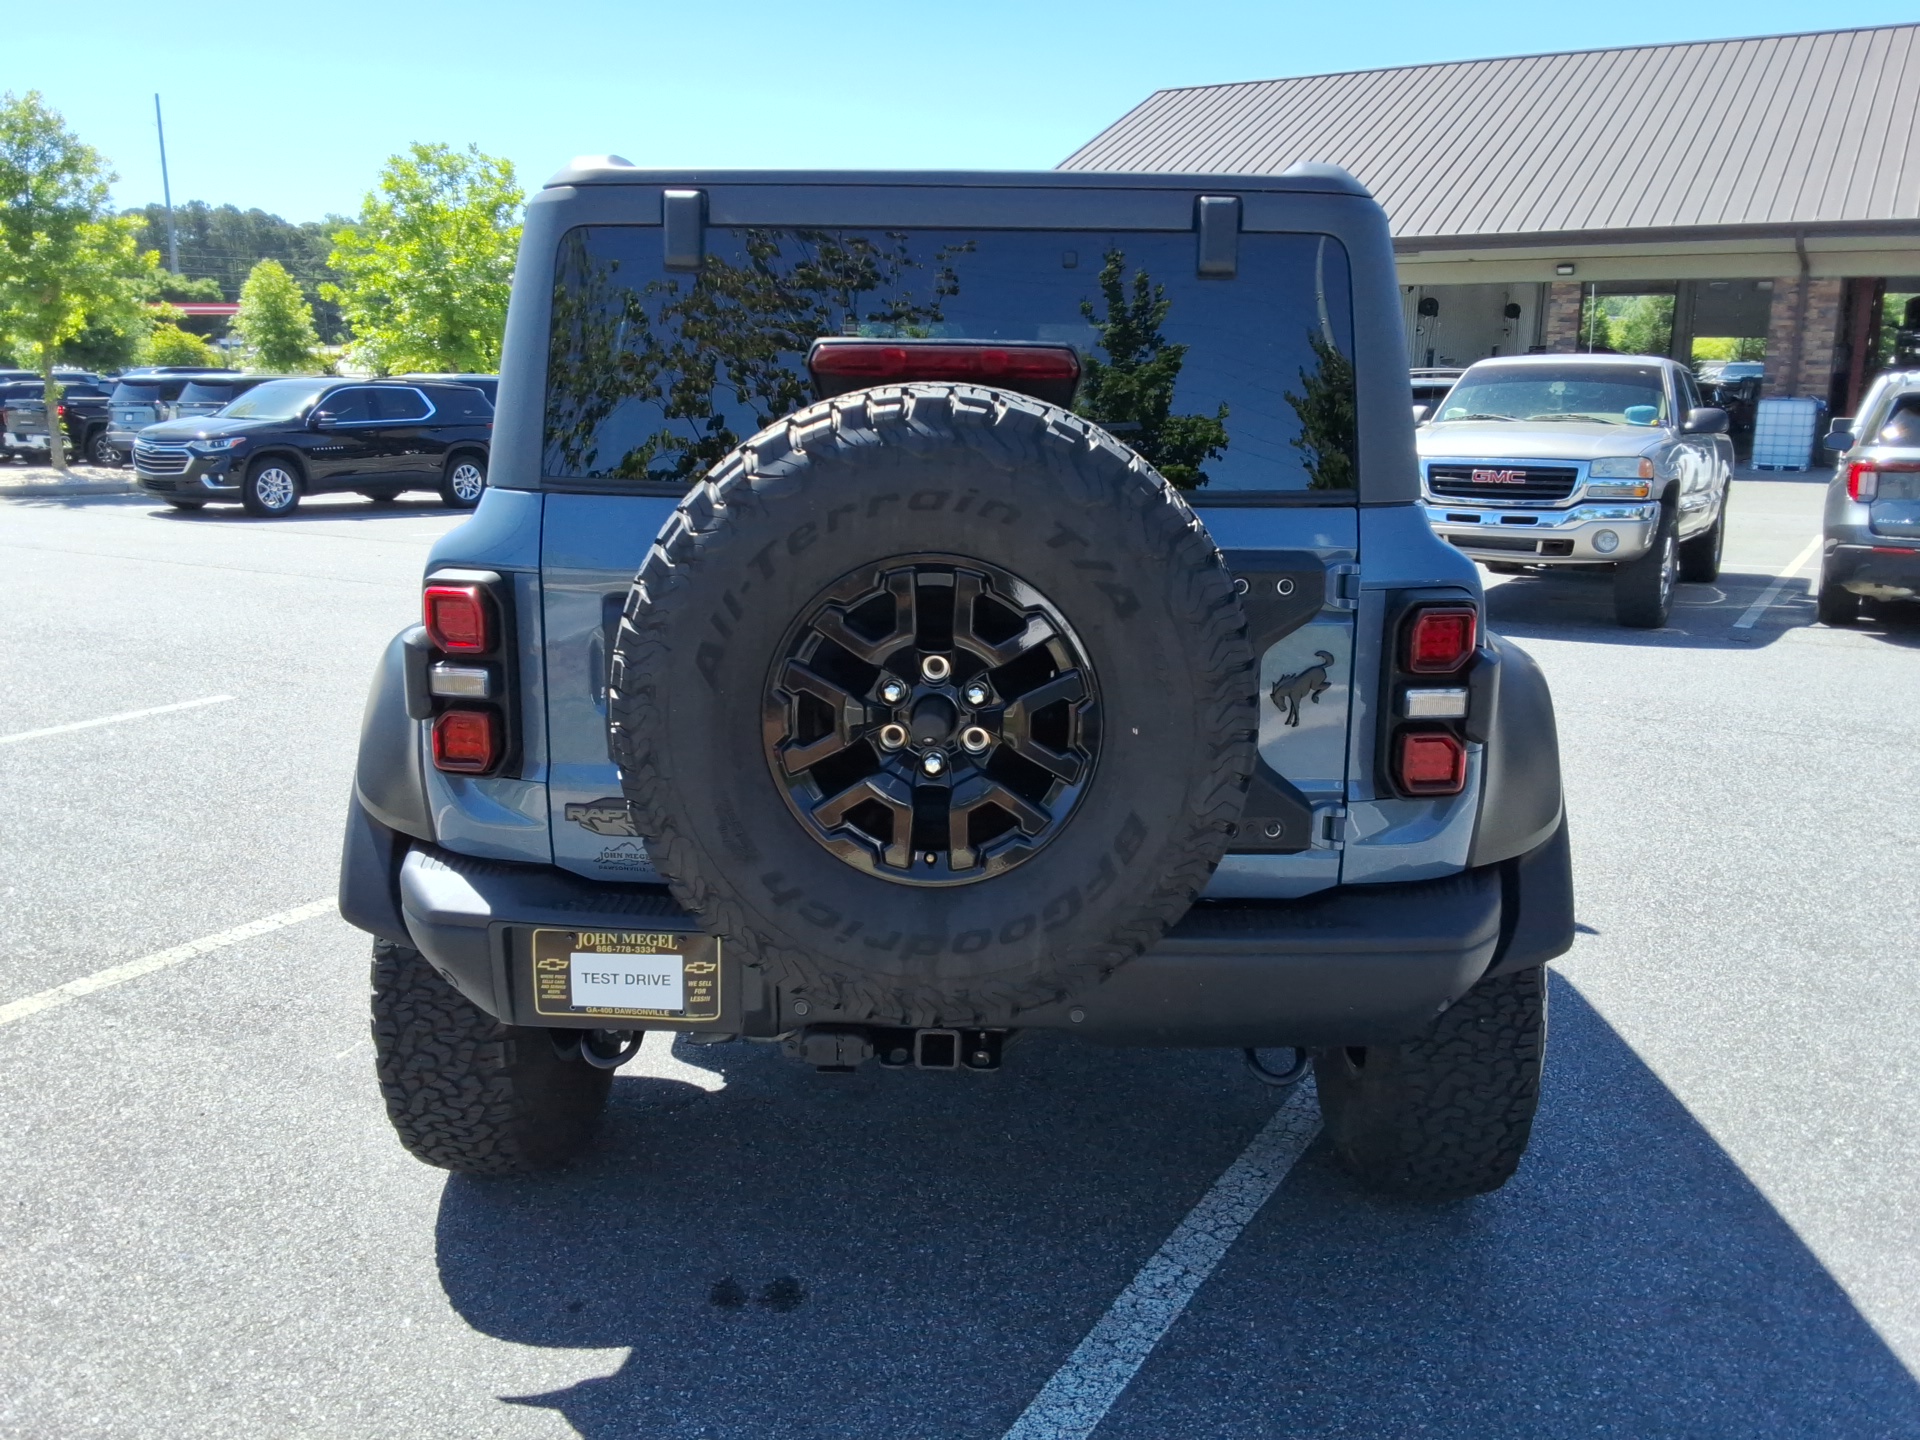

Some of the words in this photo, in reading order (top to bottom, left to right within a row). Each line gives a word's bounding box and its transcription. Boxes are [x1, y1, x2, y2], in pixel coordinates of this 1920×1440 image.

[1472, 469, 1526, 483] GMC
[696, 487, 1023, 689] All-Terrain
[600, 851, 623, 861] JOHN
[761, 809, 1149, 961] BFGoodrich
[575, 932, 618, 950] JOHN
[621, 933, 678, 950] MEGEL
[596, 945, 656, 954] 866-778-3334
[581, 972, 620, 985] TEST
[624, 973, 671, 986] DRIVE
[586, 1006, 613, 1014] GA-400
[614, 1007, 670, 1016] DAWSONVILLE
